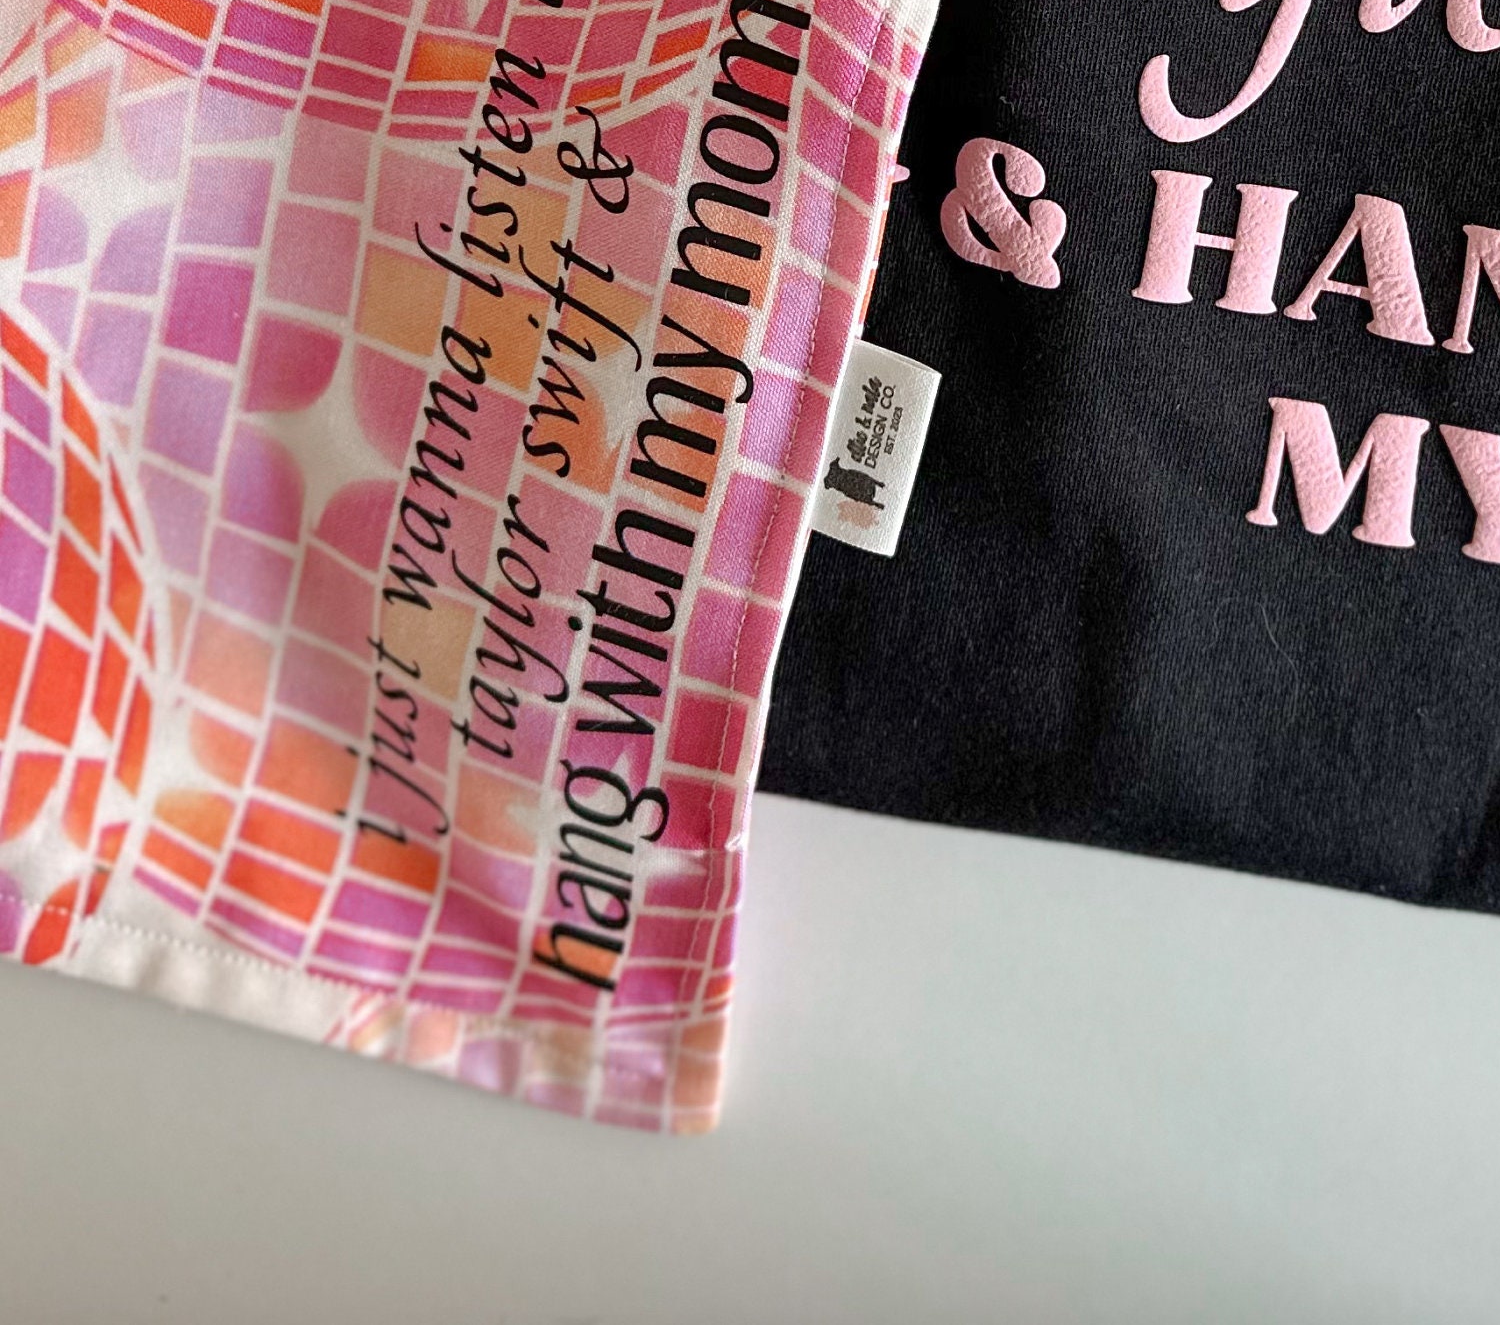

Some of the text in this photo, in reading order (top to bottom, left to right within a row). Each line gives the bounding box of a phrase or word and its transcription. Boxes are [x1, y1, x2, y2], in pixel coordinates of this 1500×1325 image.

[413, 48, 547, 299] listen
[940, 137, 1067, 290] &
[382, 325, 493, 611] wanna
[450, 105, 642, 759] taylor swift &
[629, 313, 756, 499] my
[864, 414, 888, 469] DESIGN
[566, 508, 696, 736] with
[335, 808, 408, 846] i
[346, 637, 450, 836] just
[531, 759, 671, 992] hang
